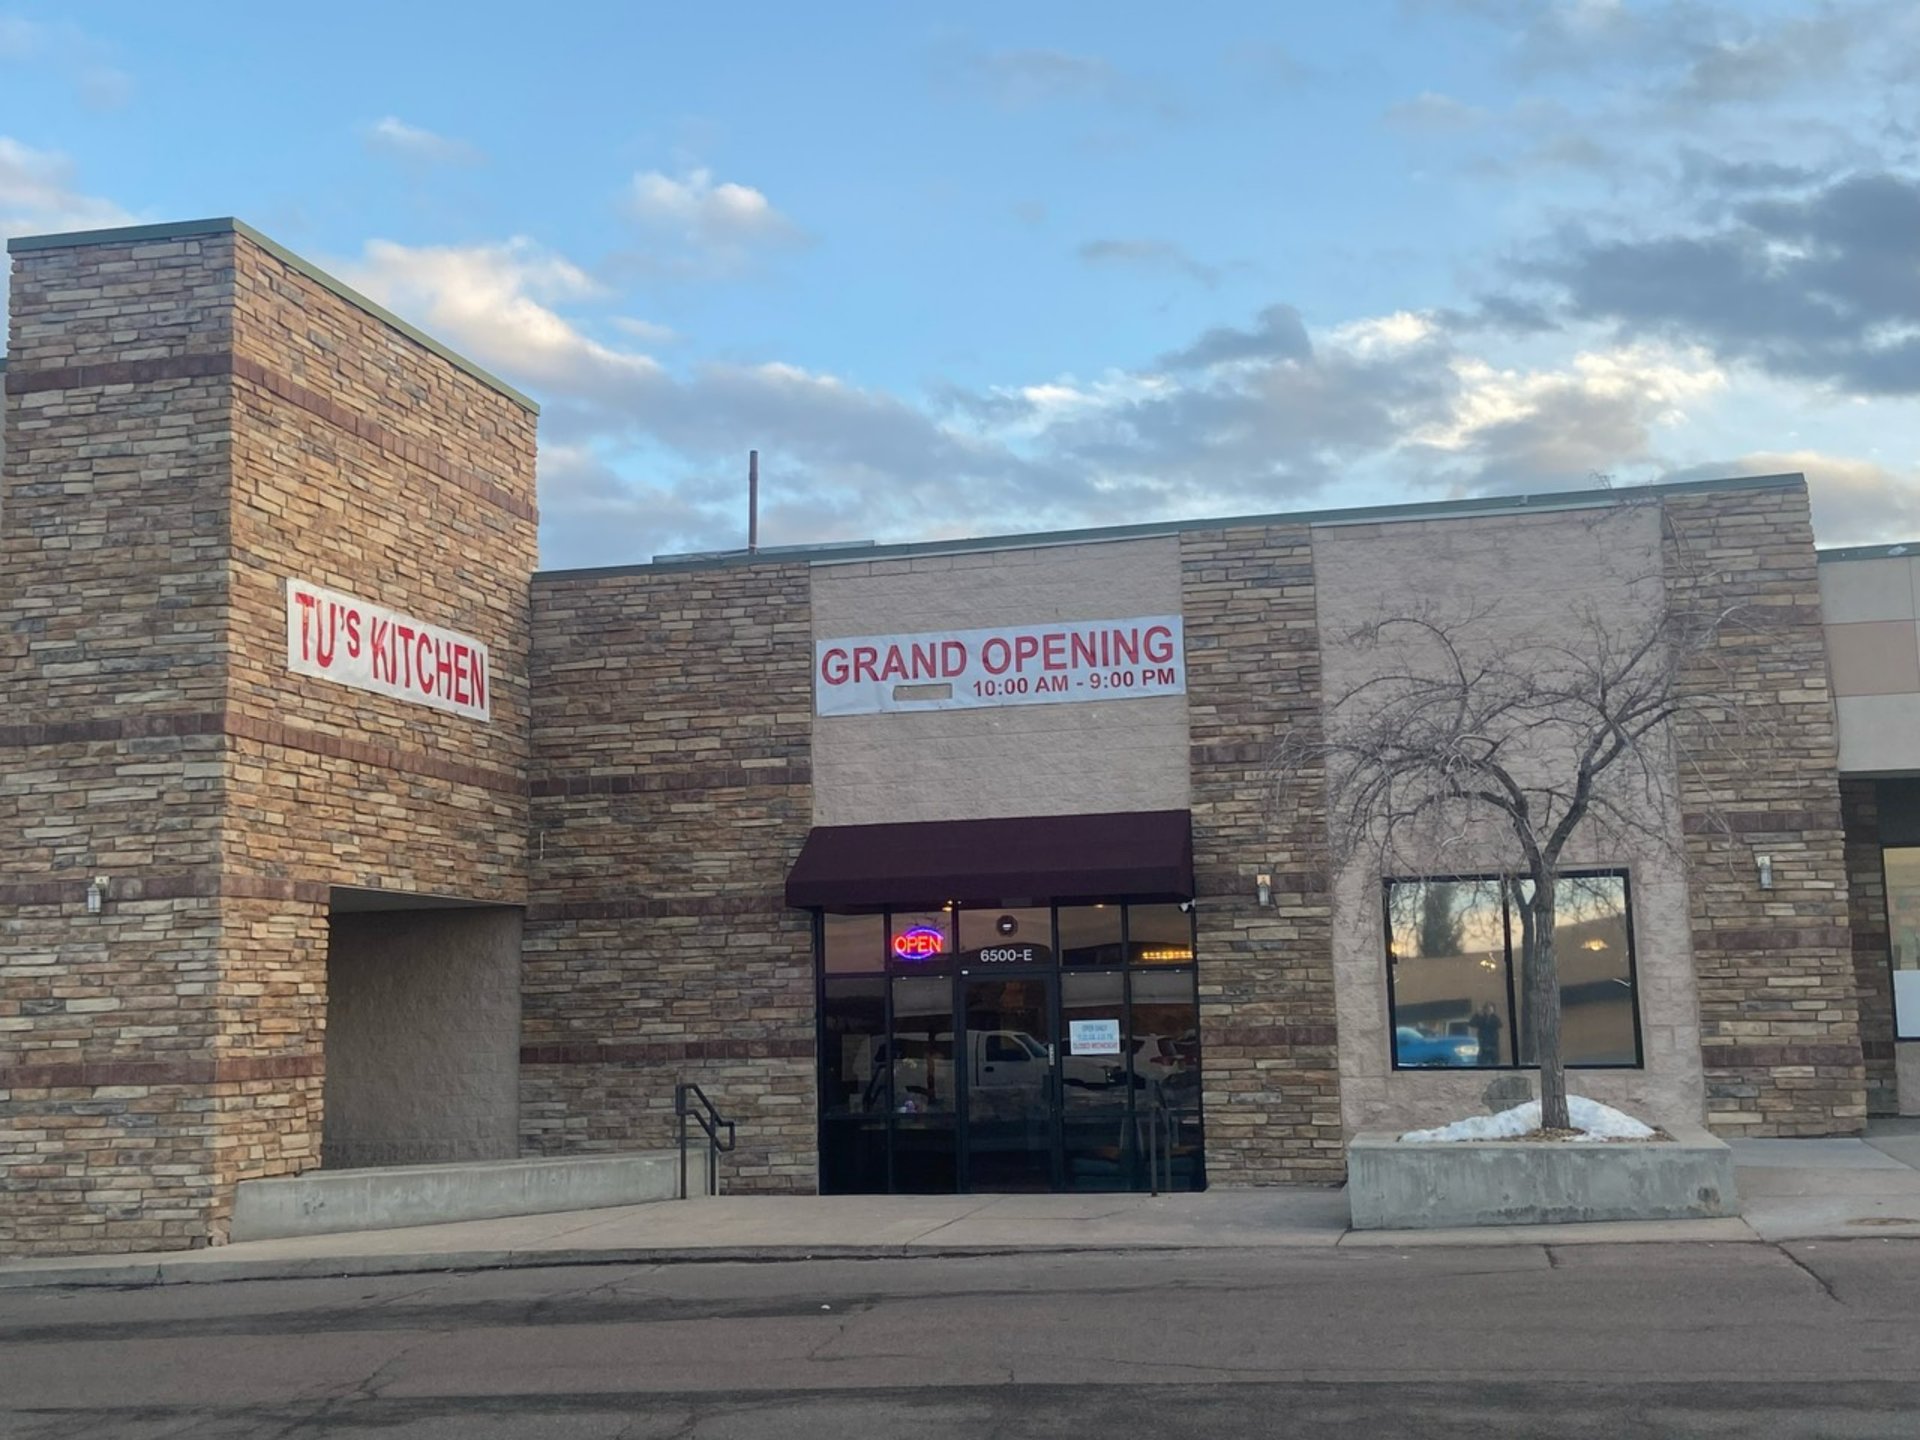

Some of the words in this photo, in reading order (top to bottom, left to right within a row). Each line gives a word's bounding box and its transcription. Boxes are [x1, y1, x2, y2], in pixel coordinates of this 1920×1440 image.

[295, 592, 360, 668] TU'S
[370, 617, 485, 709] KITCHEN
[821, 641, 967, 685] GRAND
[981, 625, 1174, 675] OPENING
[973, 679, 1028, 697] 10:00
[1035, 675, 1069, 693] AM
[1089, 671, 1135, 689] 9:00
[1142, 668, 1175, 686] PM
[894, 936, 942, 953] OPEN
[980, 949, 1033, 962] 6500-E
